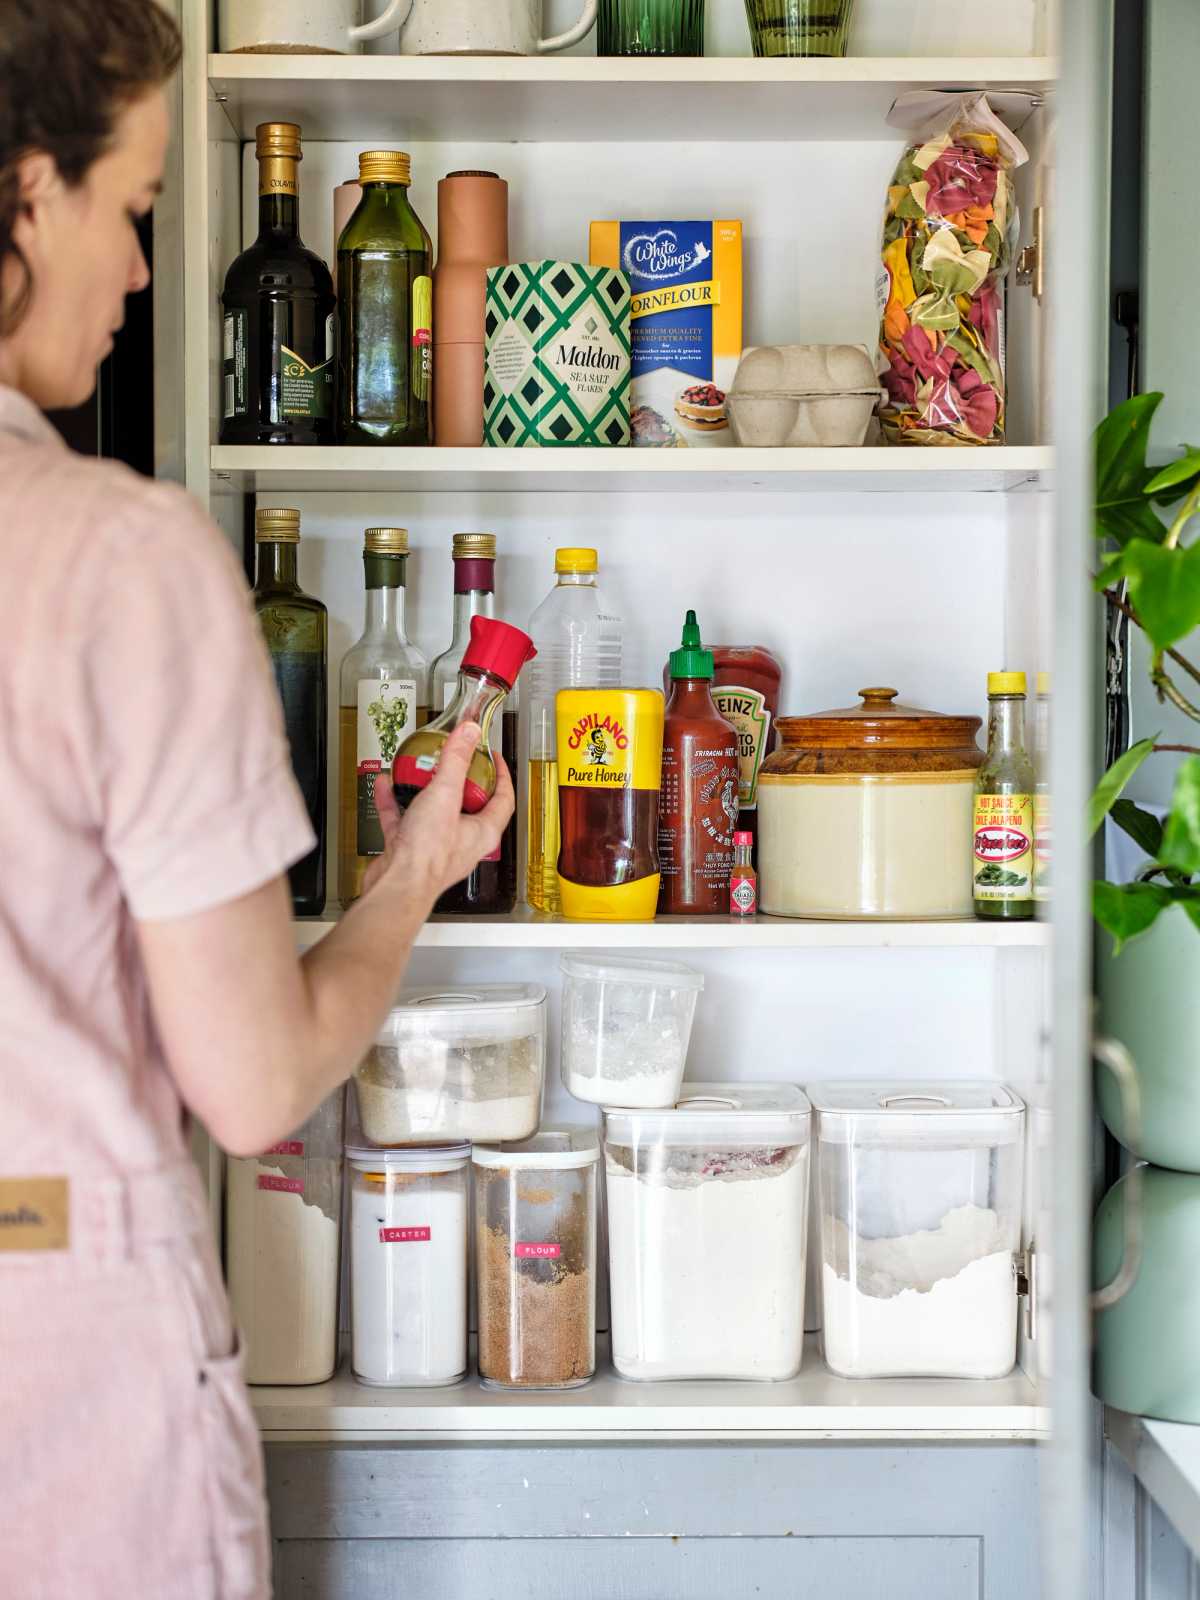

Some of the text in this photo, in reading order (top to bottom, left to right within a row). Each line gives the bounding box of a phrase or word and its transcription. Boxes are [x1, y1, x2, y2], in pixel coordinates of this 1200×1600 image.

[635, 240, 678, 262] White
[650, 251, 692, 272] Wings
[631, 286, 711, 313] ORNFLOUR
[556, 345, 620, 370] Maldon
[570, 372, 610, 385] SEA SALT
[576, 383, 603, 393] FLAKES
[717, 697, 752, 715] EINZ
[568, 713, 628, 750] CAPILANO
[568, 767, 630, 788] Pure Honey
[525, 1246, 556, 1255] FLOUR
